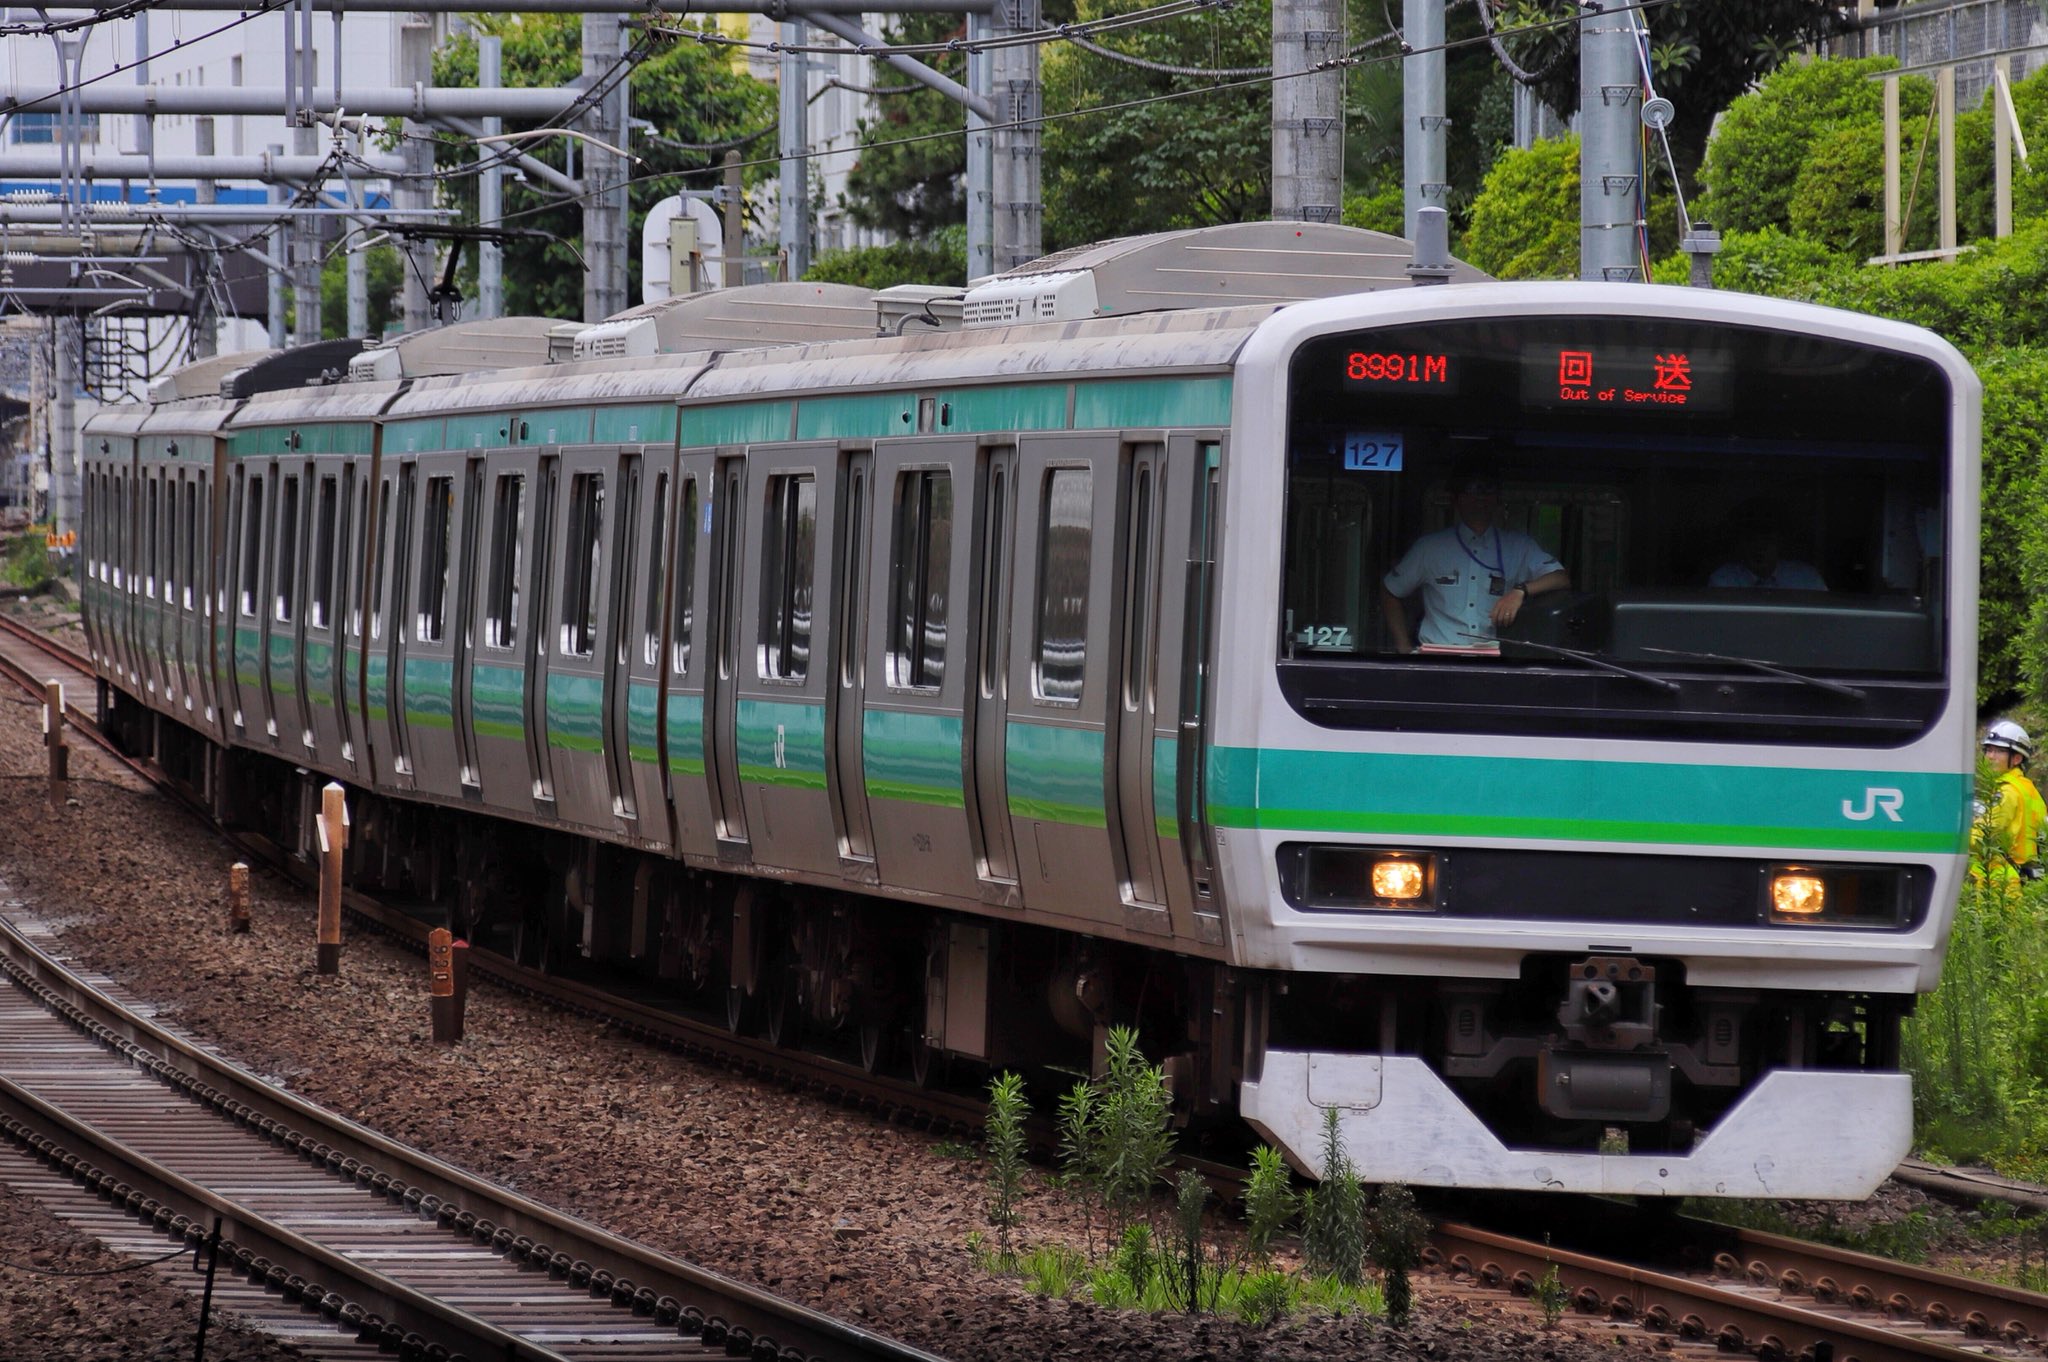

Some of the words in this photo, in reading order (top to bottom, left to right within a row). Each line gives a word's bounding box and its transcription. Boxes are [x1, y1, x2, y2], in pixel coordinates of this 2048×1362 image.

[1347, 352, 1447, 383] 8991M
[1560, 387, 1590, 401] Out
[1597, 388, 1616, 402] of
[1623, 388, 1688, 404] Service
[1348, 442, 1400, 468] 127
[1303, 625, 1349, 647] 127
[774, 723, 787, 769] JR
[1842, 787, 1905, 823] JR
